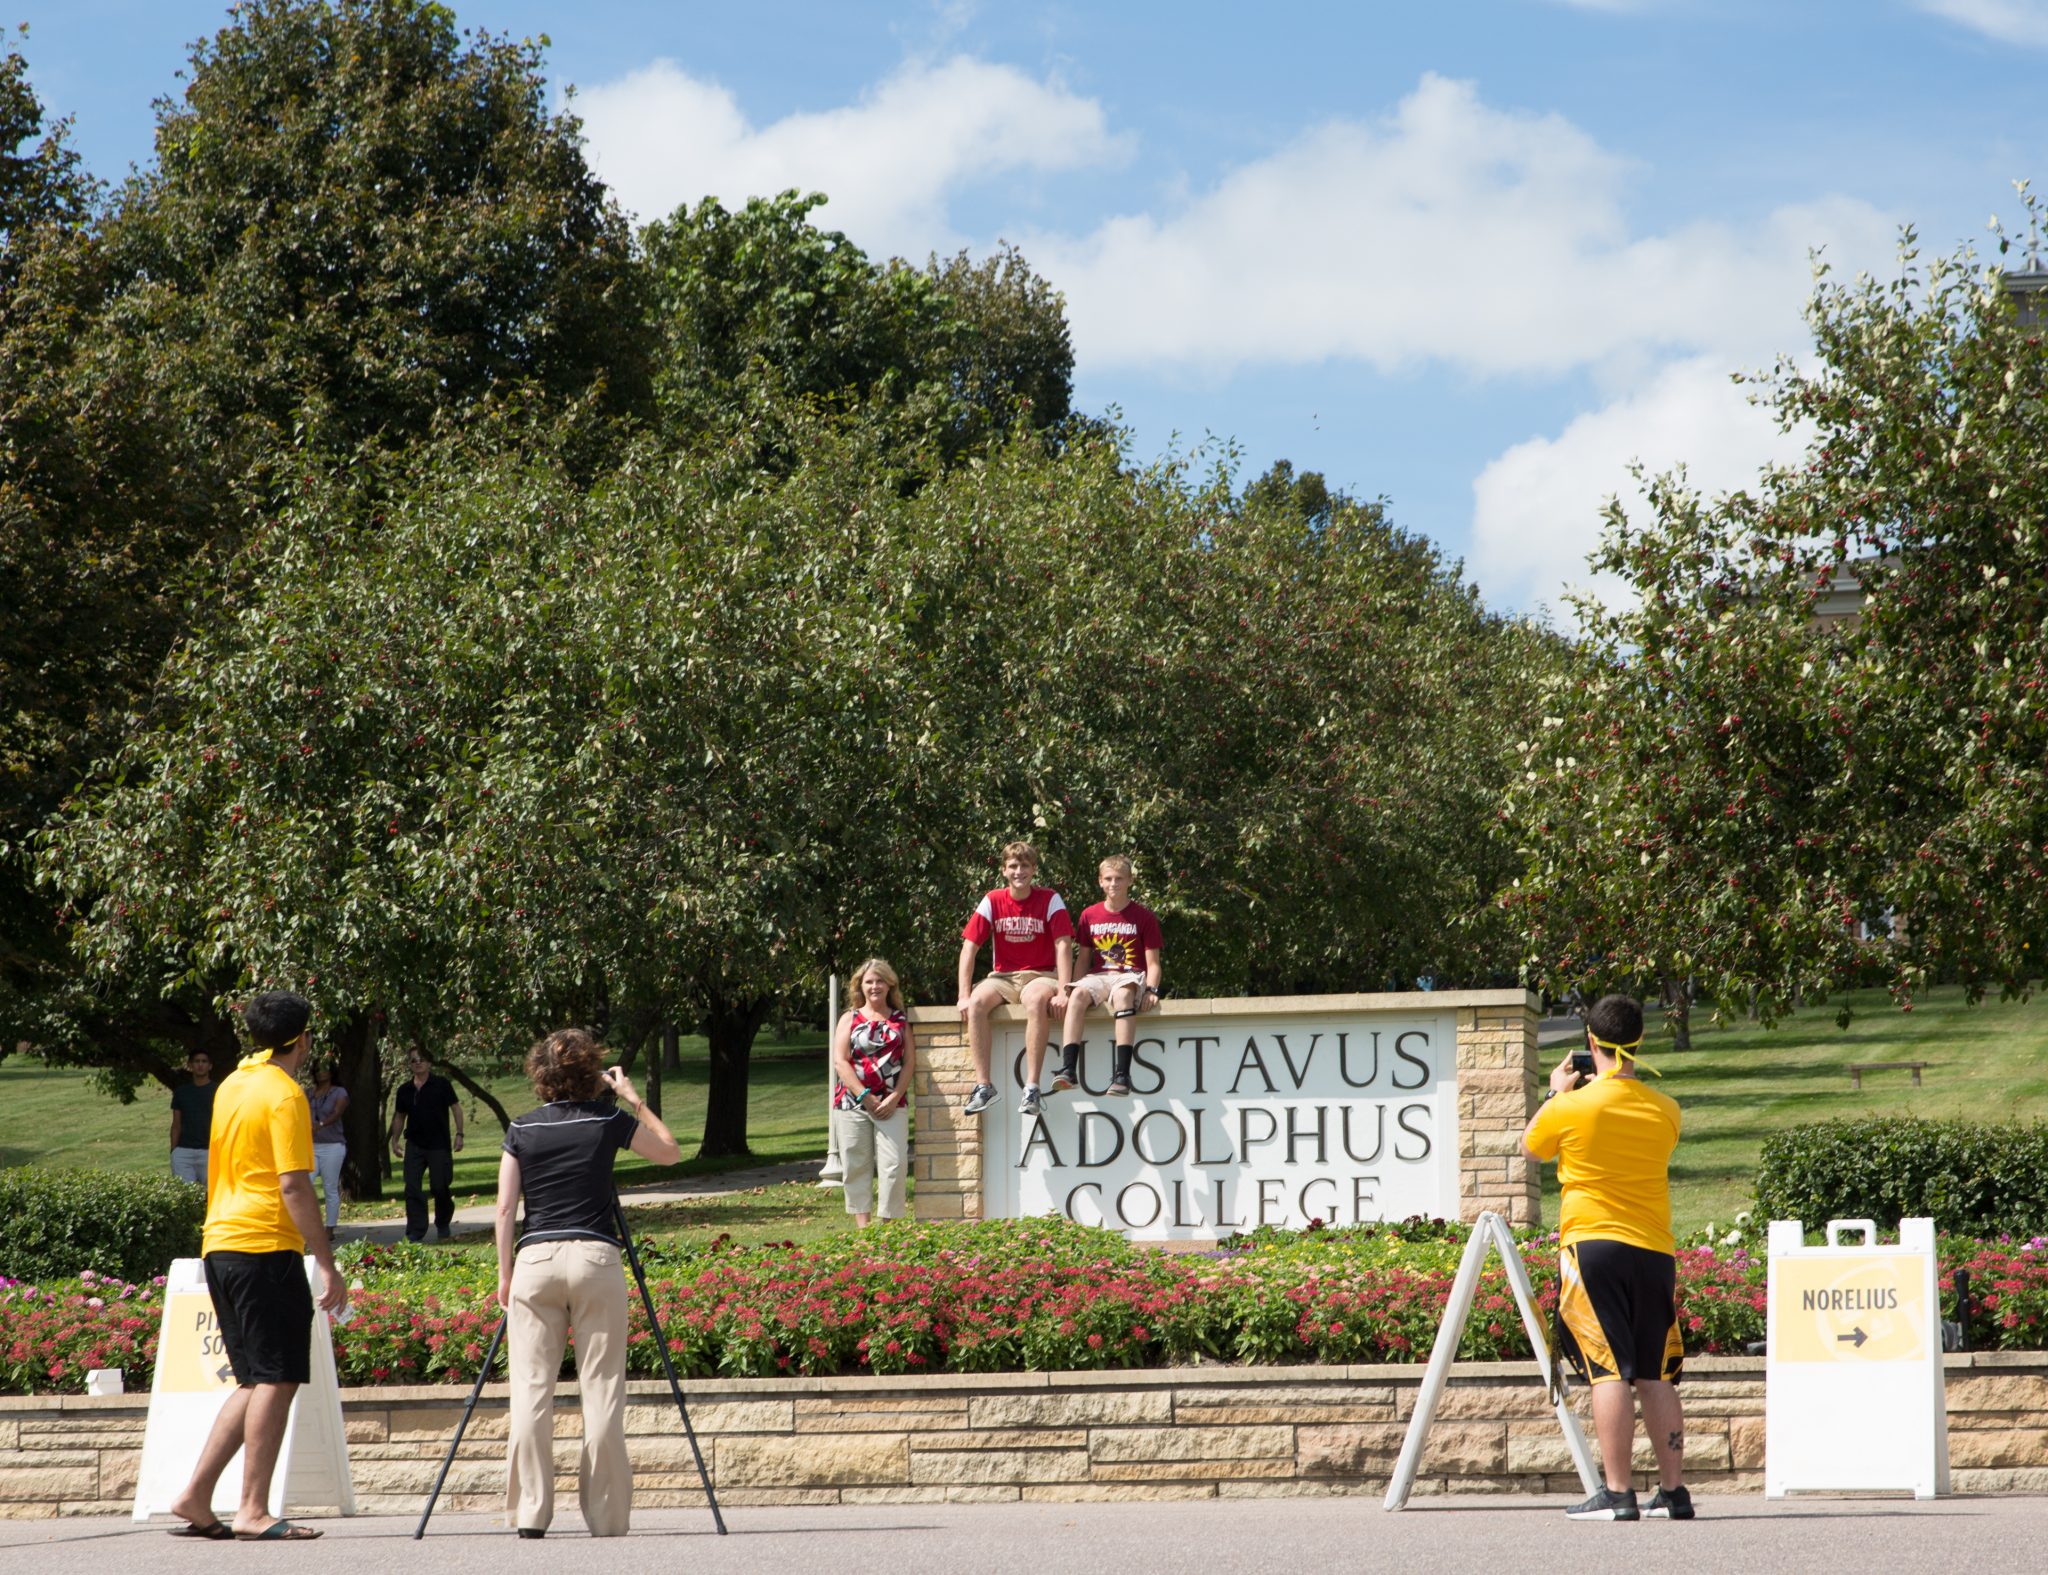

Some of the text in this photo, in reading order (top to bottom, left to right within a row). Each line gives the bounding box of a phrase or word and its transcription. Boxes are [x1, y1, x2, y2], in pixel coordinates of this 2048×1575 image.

[994, 916, 1045, 934] WISCONSIN
[1089, 922, 1138, 935] PROPAGANDA
[1014, 1030, 1431, 1097] GUSTAVUS
[1014, 1104, 1433, 1169] ADOLPHUS
[1065, 1176, 1383, 1229] COLLEGE
[1803, 1288, 1898, 1311] NORELIUS
[195, 1311, 220, 1331] PI
[202, 1335, 227, 1355] SO
